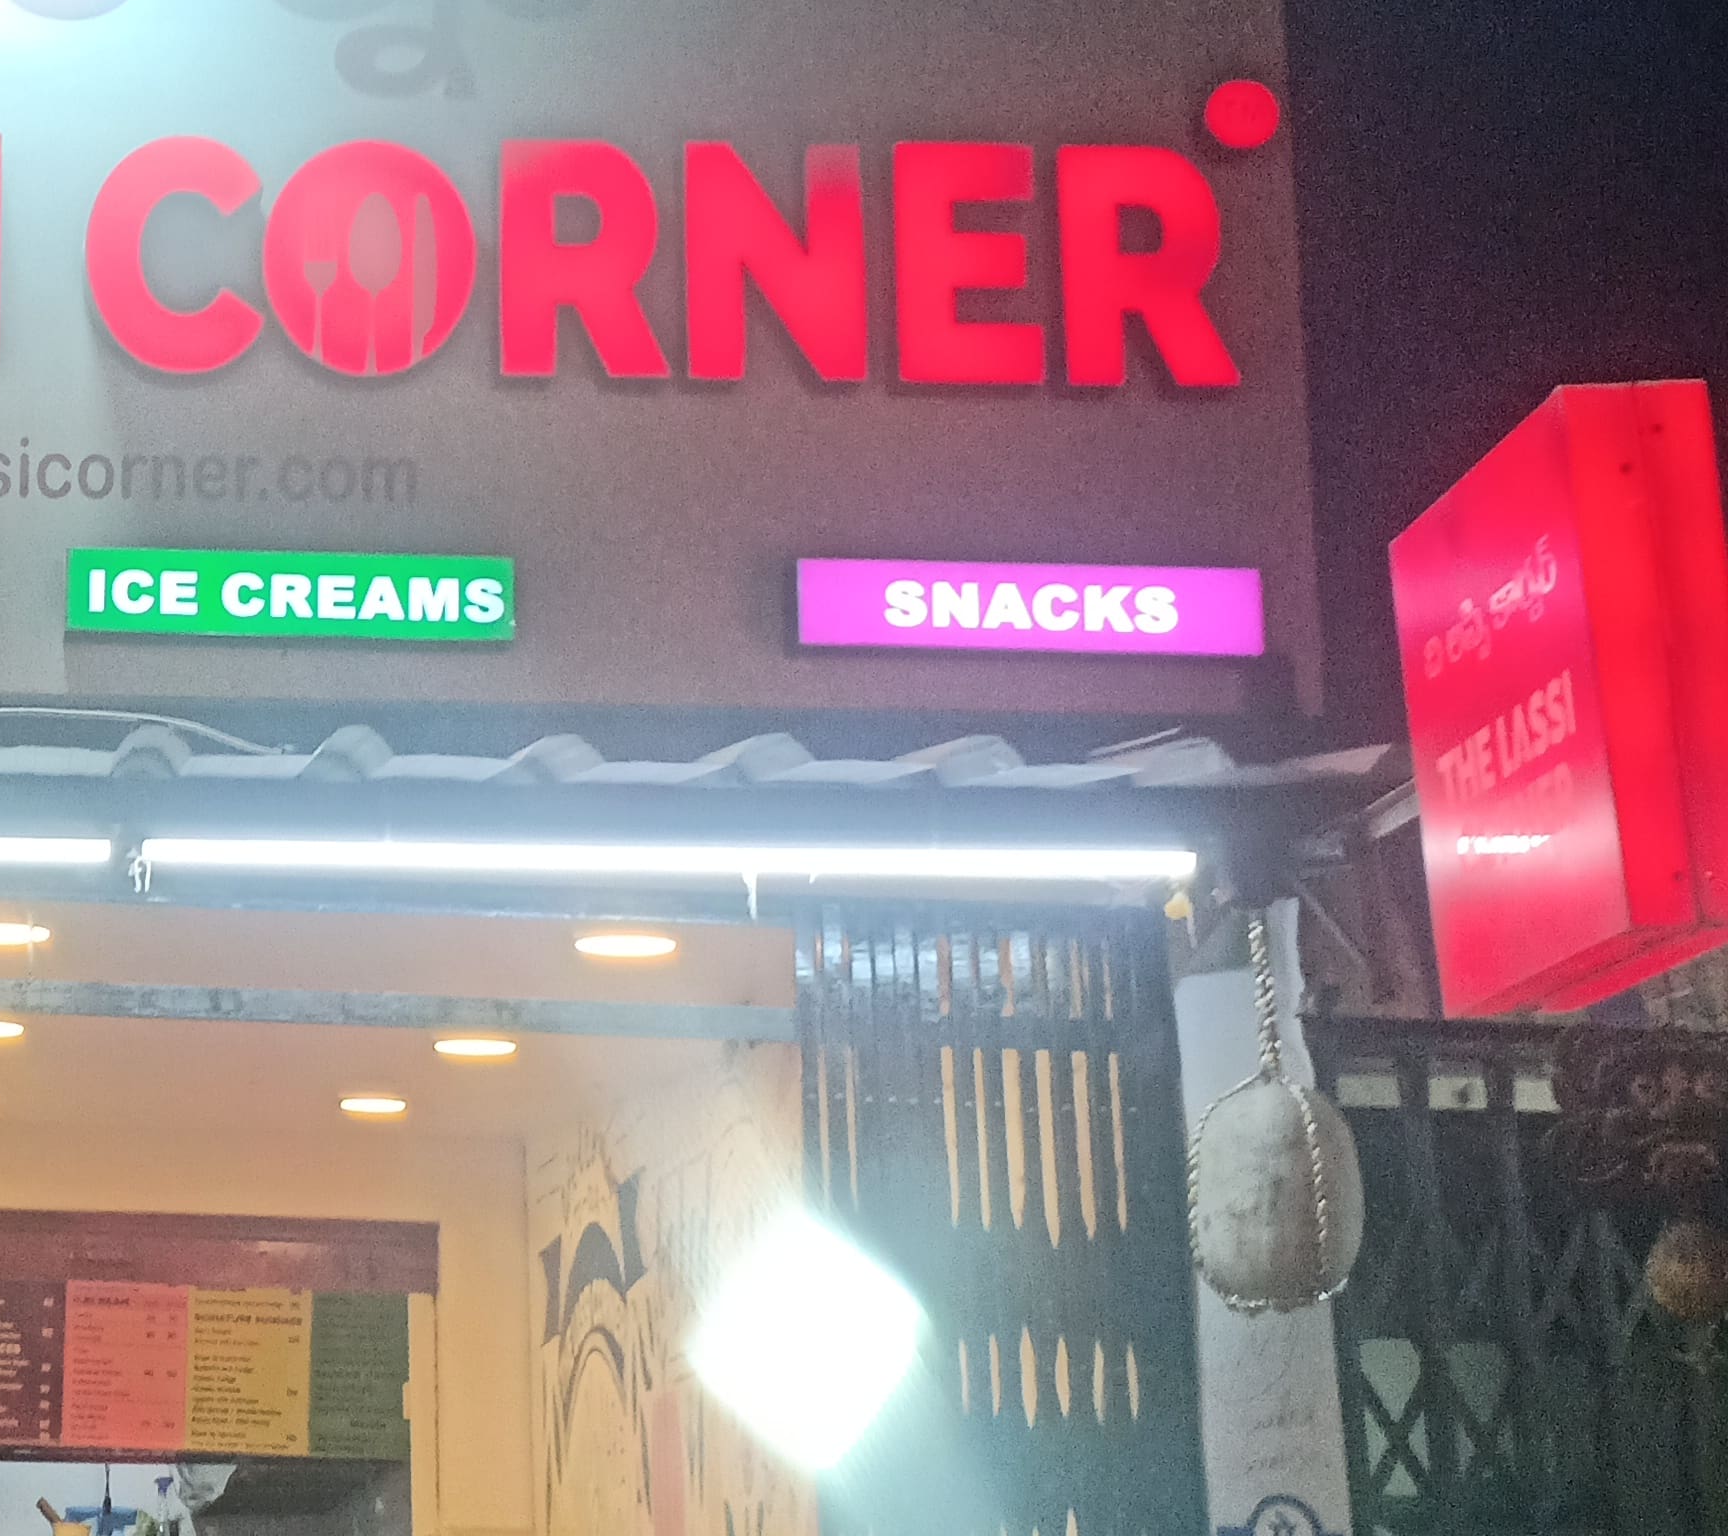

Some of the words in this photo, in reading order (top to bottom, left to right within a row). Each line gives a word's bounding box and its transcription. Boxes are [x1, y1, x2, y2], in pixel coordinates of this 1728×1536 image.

[84, 135, 1243, 388] CORNER
[84, 567, 203, 619] ICE
[219, 570, 508, 628] CREAMS
[882, 578, 1182, 637] SNACKS
[1436, 722, 1494, 811] THE
[1495, 668, 1577, 778] LASSI
